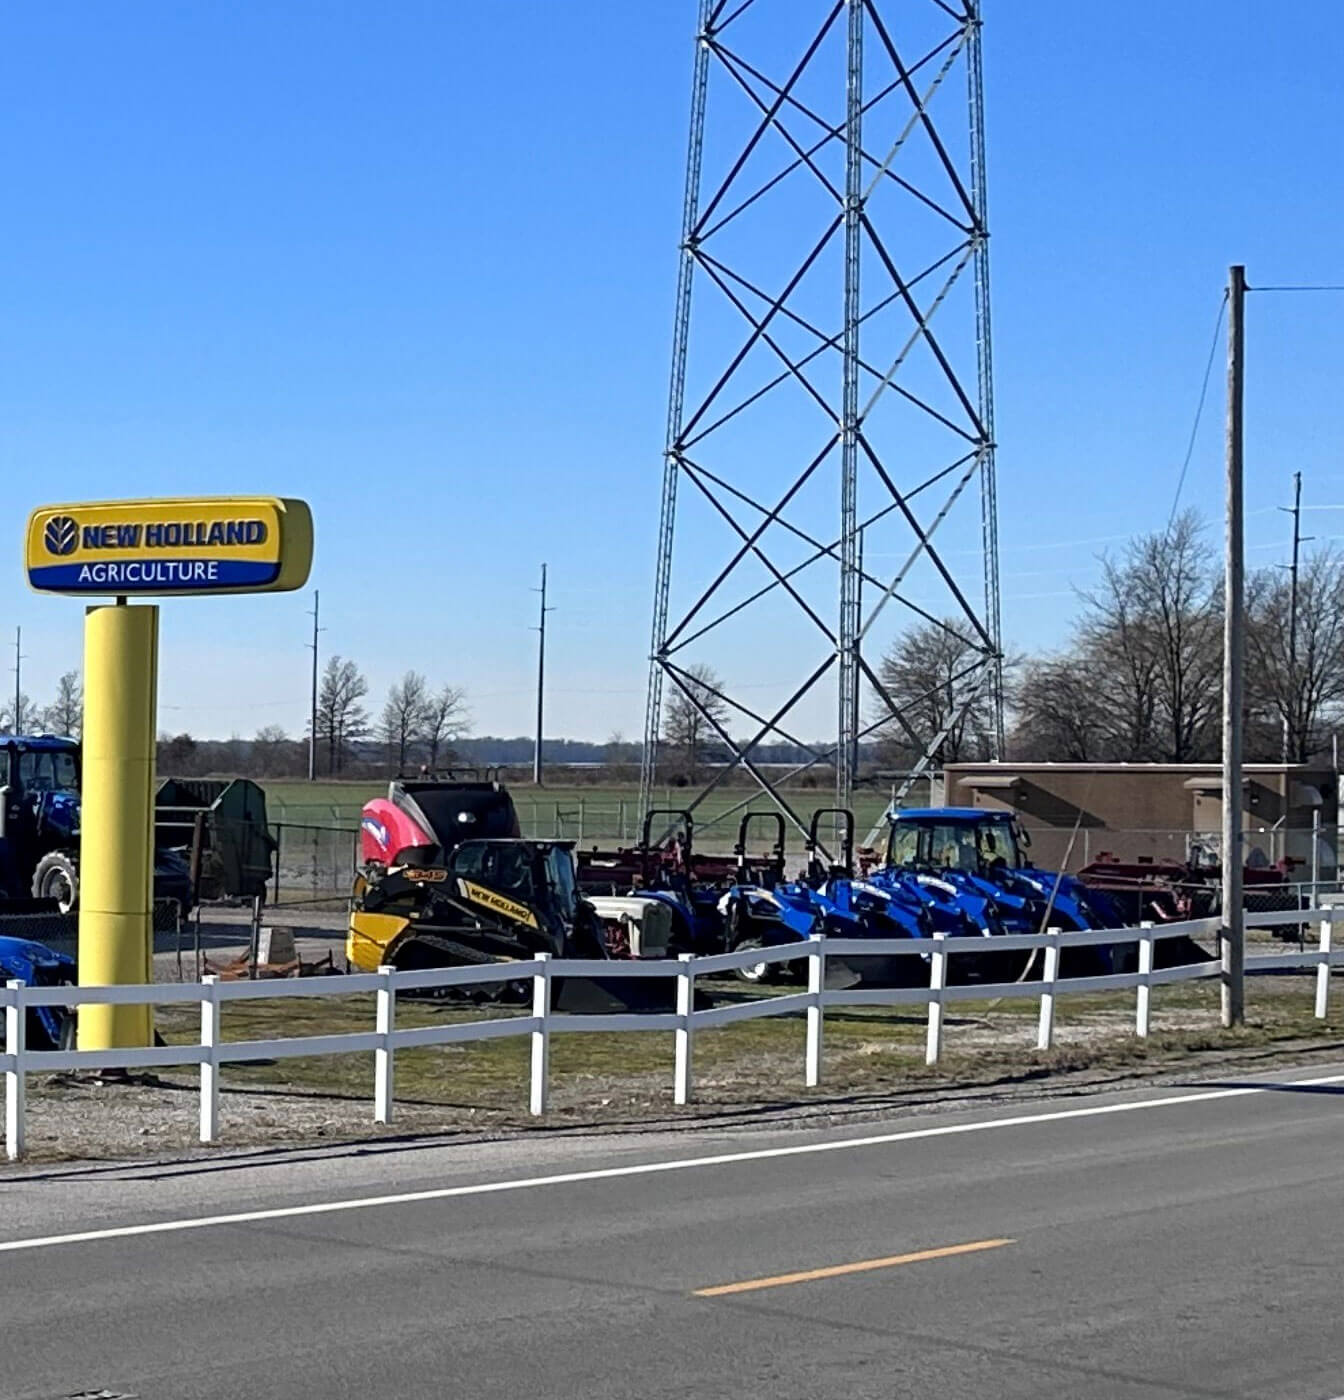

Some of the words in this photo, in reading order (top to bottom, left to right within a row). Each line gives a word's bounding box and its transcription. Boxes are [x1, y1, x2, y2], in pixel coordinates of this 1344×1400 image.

[82, 524, 142, 550] NEW
[145, 519, 268, 547] HOLLAND
[78, 561, 218, 582] AGRICULTURE
